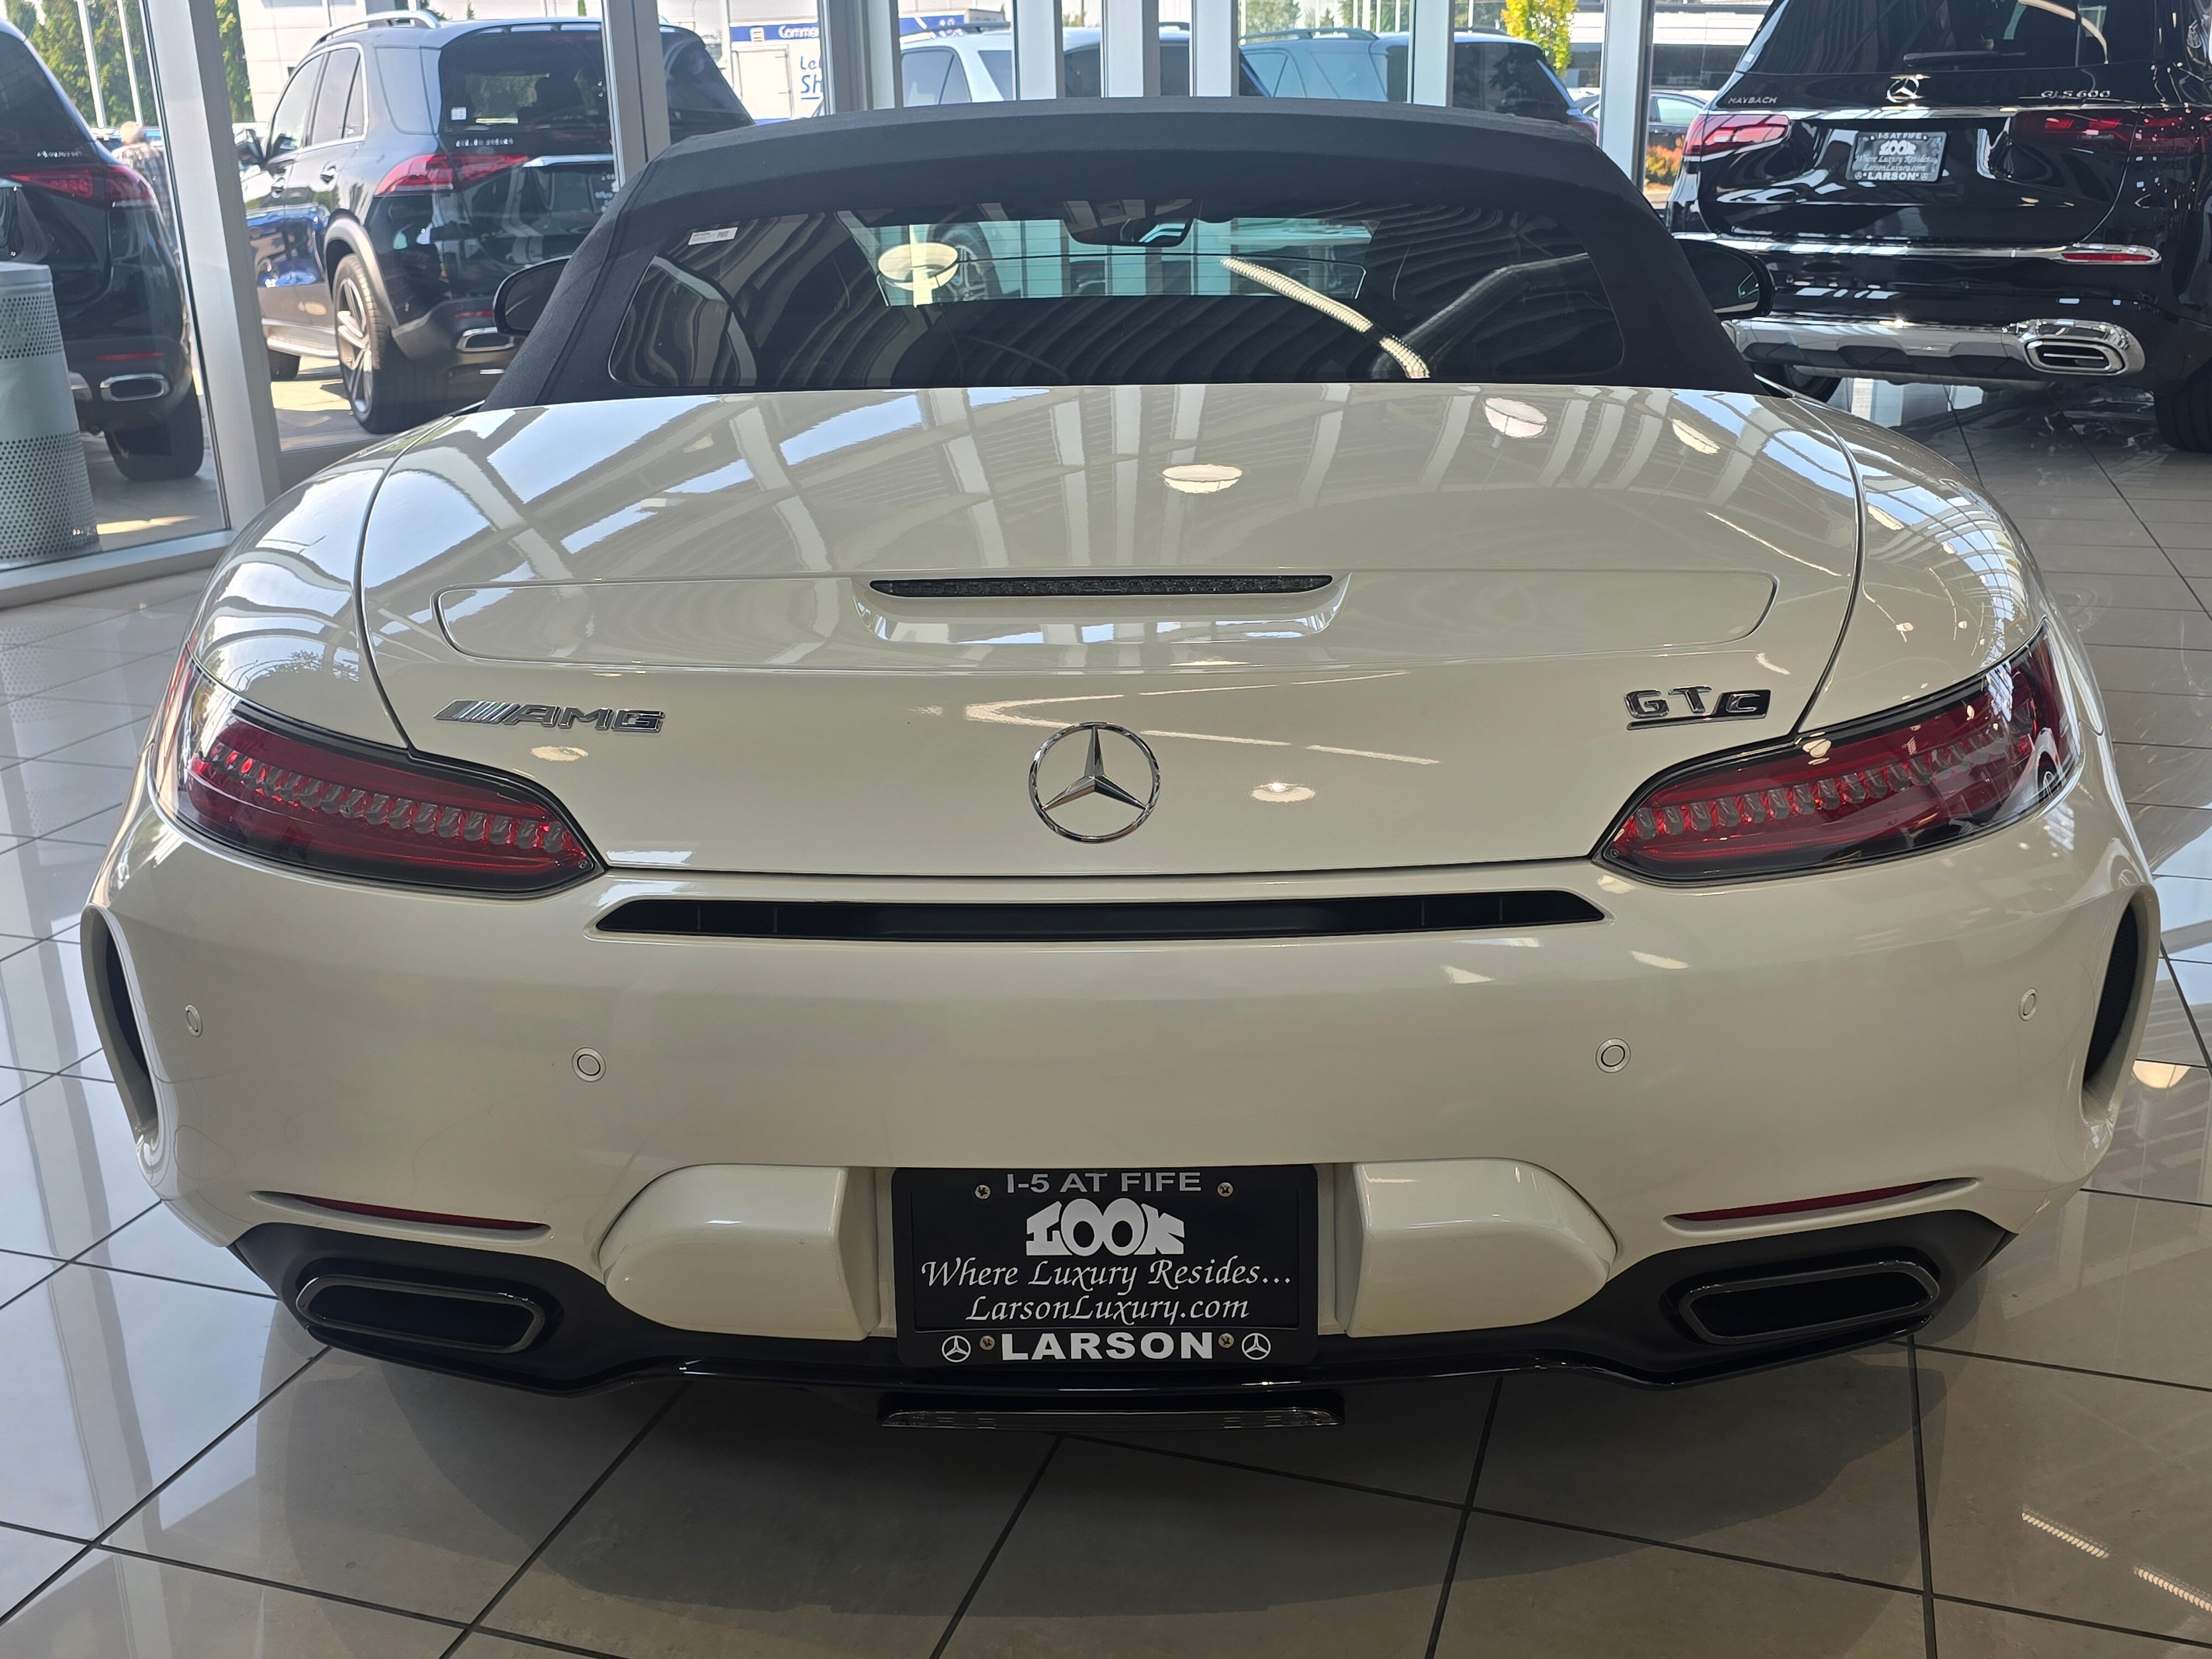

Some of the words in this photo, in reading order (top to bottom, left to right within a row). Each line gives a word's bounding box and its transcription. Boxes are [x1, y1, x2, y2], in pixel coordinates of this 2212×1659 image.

[1867, 172, 1916, 180] LARSON
[1007, 1173, 1050, 1193] I-5
[1060, 1172, 1108, 1193] AT
[1120, 1171, 1202, 1192] FIFE
[921, 1256, 1019, 1287] Where
[1027, 1260, 1137, 1296] Luxury
[1147, 1255, 1292, 1291] Resides...
[965, 1295, 1250, 1326] LarsonLuxury.com
[1001, 1331, 1213, 1361] LARSON
